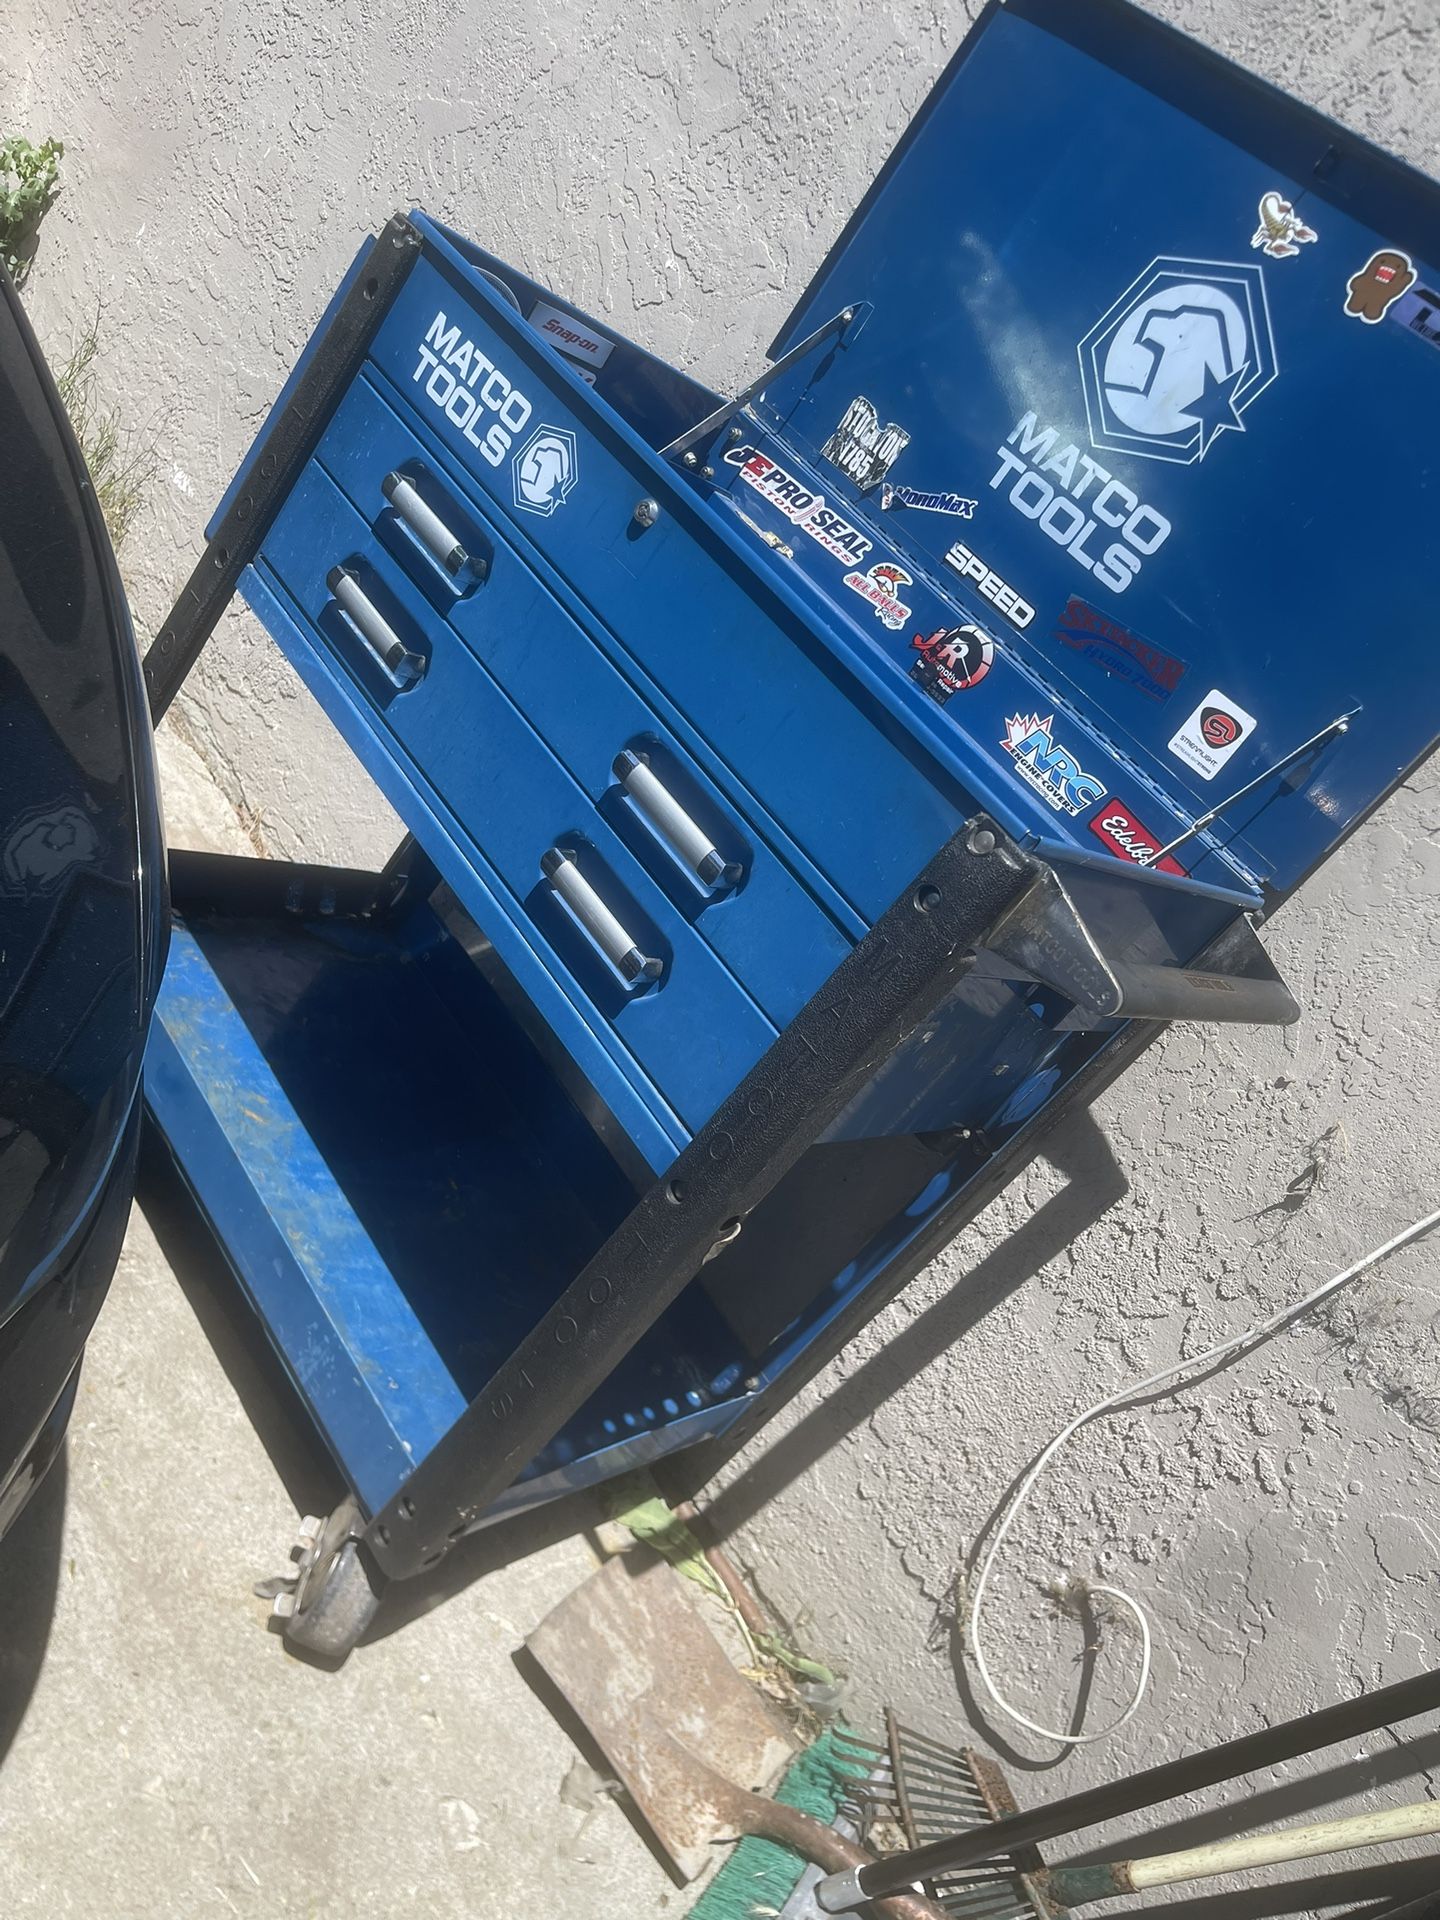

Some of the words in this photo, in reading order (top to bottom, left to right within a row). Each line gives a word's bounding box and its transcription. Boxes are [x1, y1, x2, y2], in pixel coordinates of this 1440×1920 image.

[412, 344, 512, 468] TOOLS
[424, 311, 532, 434] MATCO
[838, 439, 874, 480] 1785
[1006, 410, 1172, 556] MATCO
[742, 470, 796, 515] PISTON
[804, 523, 855, 563] RINGS
[810, 510, 870, 560] SEAL
[989, 446, 1142, 594] TOOLS
[846, 574, 872, 595] ALL
[866, 587, 909, 620] BALLS
[945, 542, 1036, 629] SPEED
[1009, 748, 1043, 781] ENGINE
[1041, 778, 1076, 814] COVERS
[1016, 729, 1106, 811] NRC
